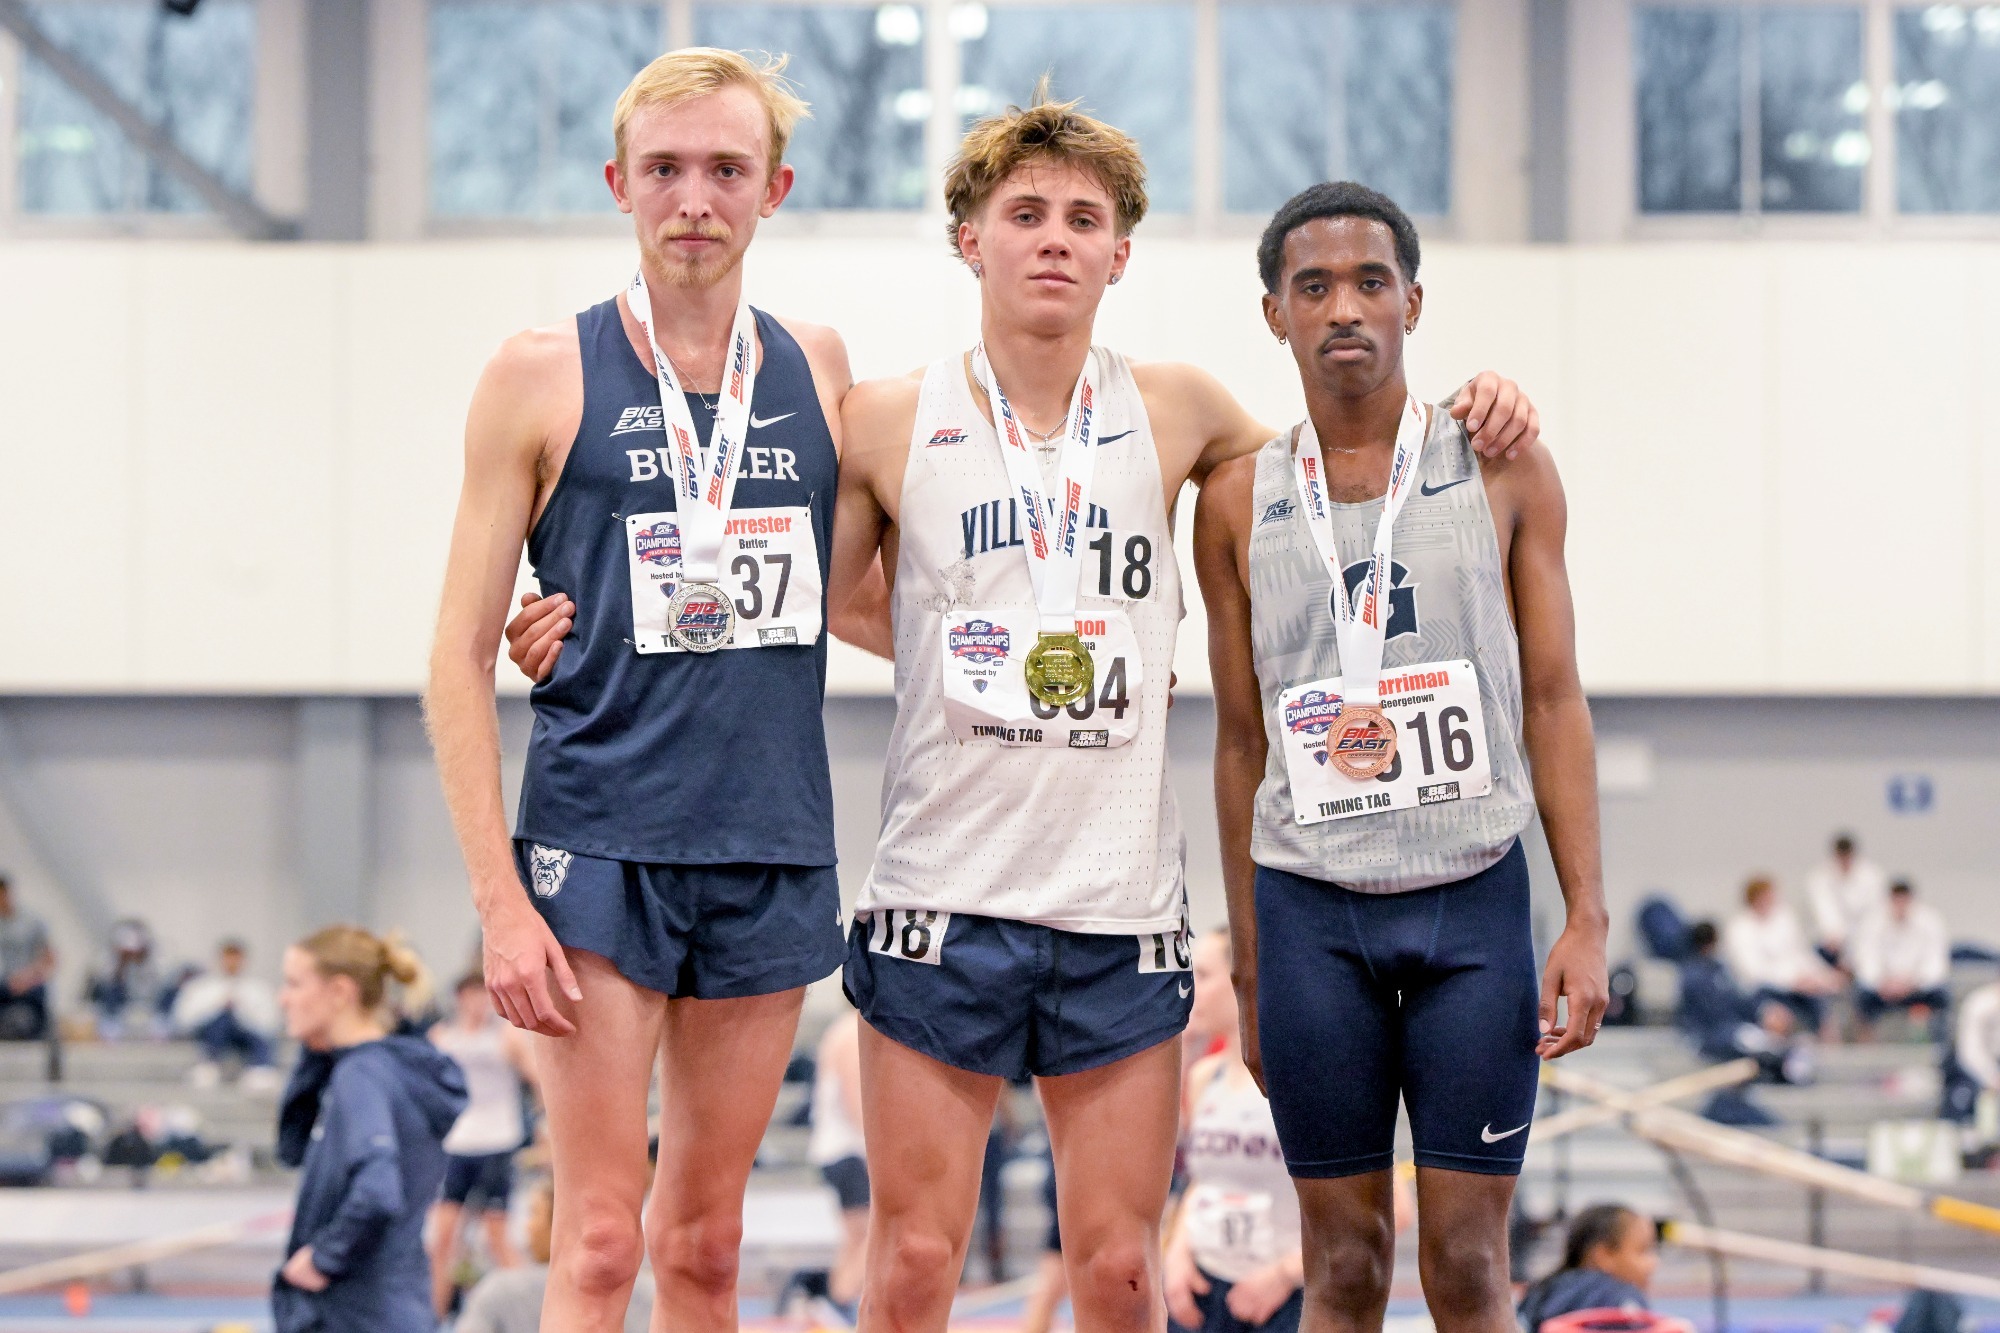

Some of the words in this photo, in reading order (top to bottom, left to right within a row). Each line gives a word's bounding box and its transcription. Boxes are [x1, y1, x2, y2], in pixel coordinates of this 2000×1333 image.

[734, 331, 745, 375] EAST
[730, 370, 741, 399] BIG
[1084, 383, 1093, 409] BIG
[614, 417, 665, 430] EAS
[620, 406, 663, 418] BIG
[935, 428, 962, 437] BIG
[1004, 418, 1019, 447] BIG
[1080, 406, 1092, 447] EAST
[679, 427, 694, 458] BIG
[929, 435, 968, 444] EAST
[626, 446, 799, 482] BUER
[707, 475, 720, 505] BIG
[714, 433, 730, 479] EAST
[1308, 457, 1317, 480] BIG
[1392, 443, 1406, 486] EAST
[685, 455, 698, 501] EAST
[1071, 482, 1081, 512] BIG
[1311, 480, 1326, 519] EAST
[724, 516, 792, 536] orrester
[1021, 486, 1039, 532] EAST
[1031, 529, 1045, 560] BIG
[1065, 510, 1078, 558] EAST
[636, 537, 680, 551] CHAMPIONSH
[739, 538, 768, 550] Butler
[1089, 532, 1151, 600] 18
[1366, 553, 1377, 596] EAST
[730, 553, 792, 620] 37
[676, 613, 730, 625] EAST
[683, 602, 721, 614] BIG
[1363, 594, 1374, 625] BIG
[761, 636, 797, 645] CHANGE
[950, 634, 1009, 647] CHAMPIONSHIPS
[963, 668, 987, 676] Hosted
[988, 669, 997, 678] by
[1379, 670, 1450, 696] arriman
[1286, 702, 1342, 722] CHAMPIONSHIPS
[1381, 693, 1435, 710] Georgetown
[972, 725, 1016, 742] TIMING
[1019, 728, 1043, 743] TAG
[1070, 739, 1107, 747] CHANGE
[1303, 739, 1326, 749] Hosted
[1337, 739, 1391, 750] EAST
[1342, 728, 1381, 740] BIG
[1318, 797, 1364, 817] TIMING
[1365, 792, 1391, 808] TAG
[1420, 791, 1459, 804] CHANGE
[880, 909, 938, 960] 18
